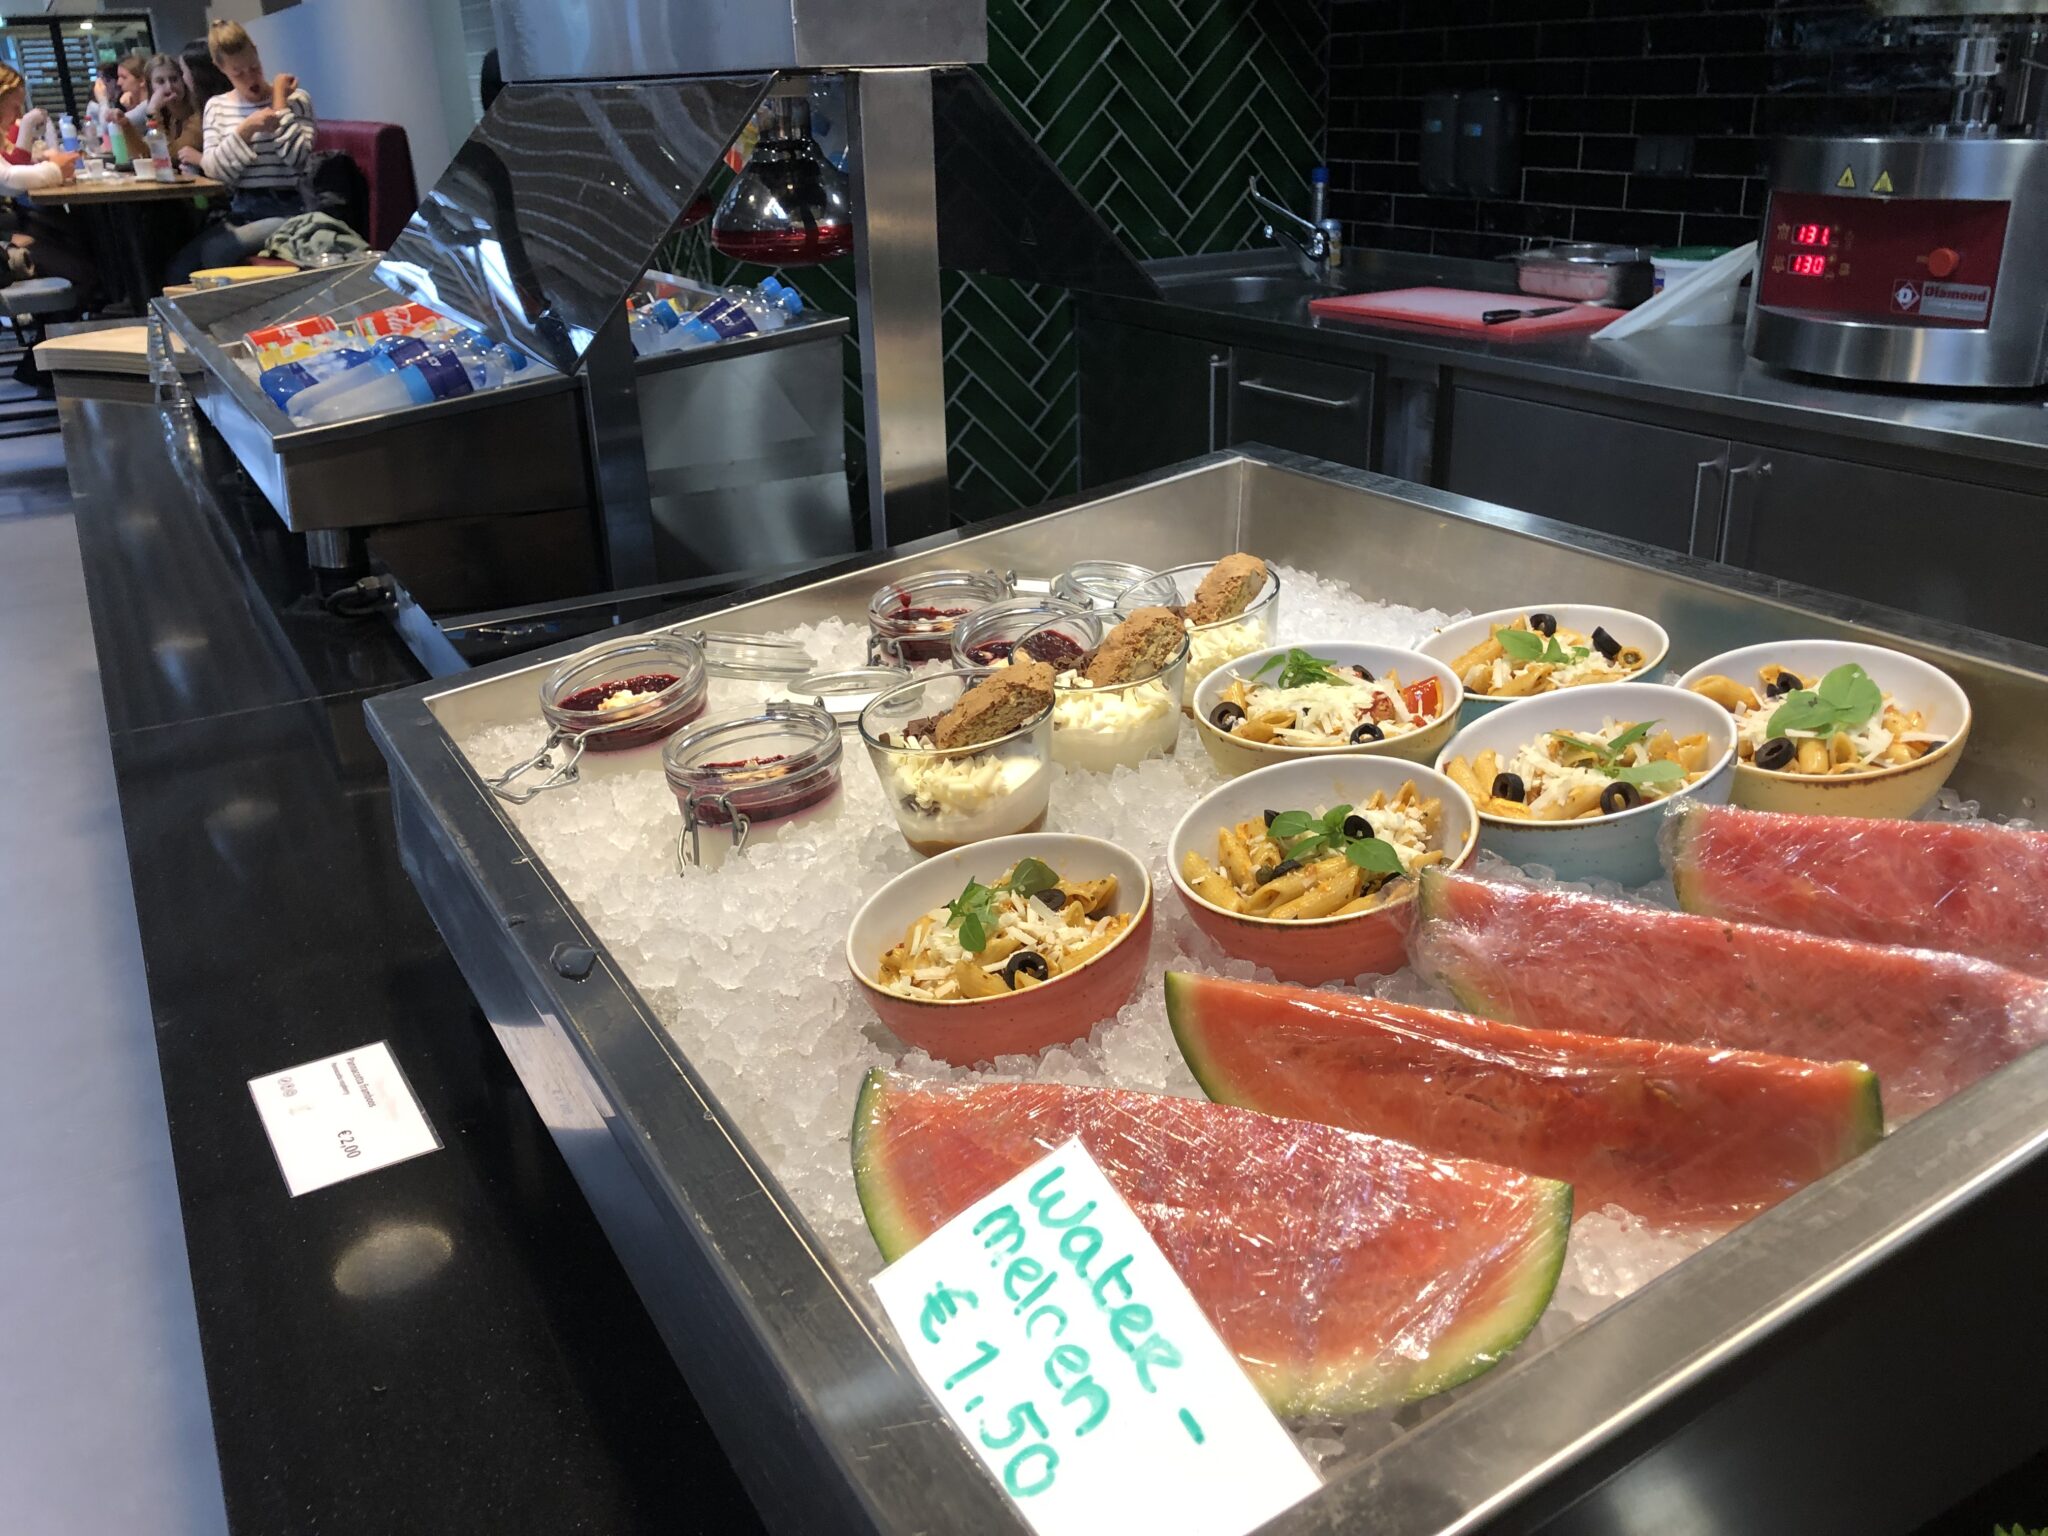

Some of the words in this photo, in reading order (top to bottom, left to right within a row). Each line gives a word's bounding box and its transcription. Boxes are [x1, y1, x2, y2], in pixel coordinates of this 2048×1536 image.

[1798, 224, 1830, 246] 131
[1794, 255, 1825, 275] 130
[1924, 285, 1988, 302] Diamond
